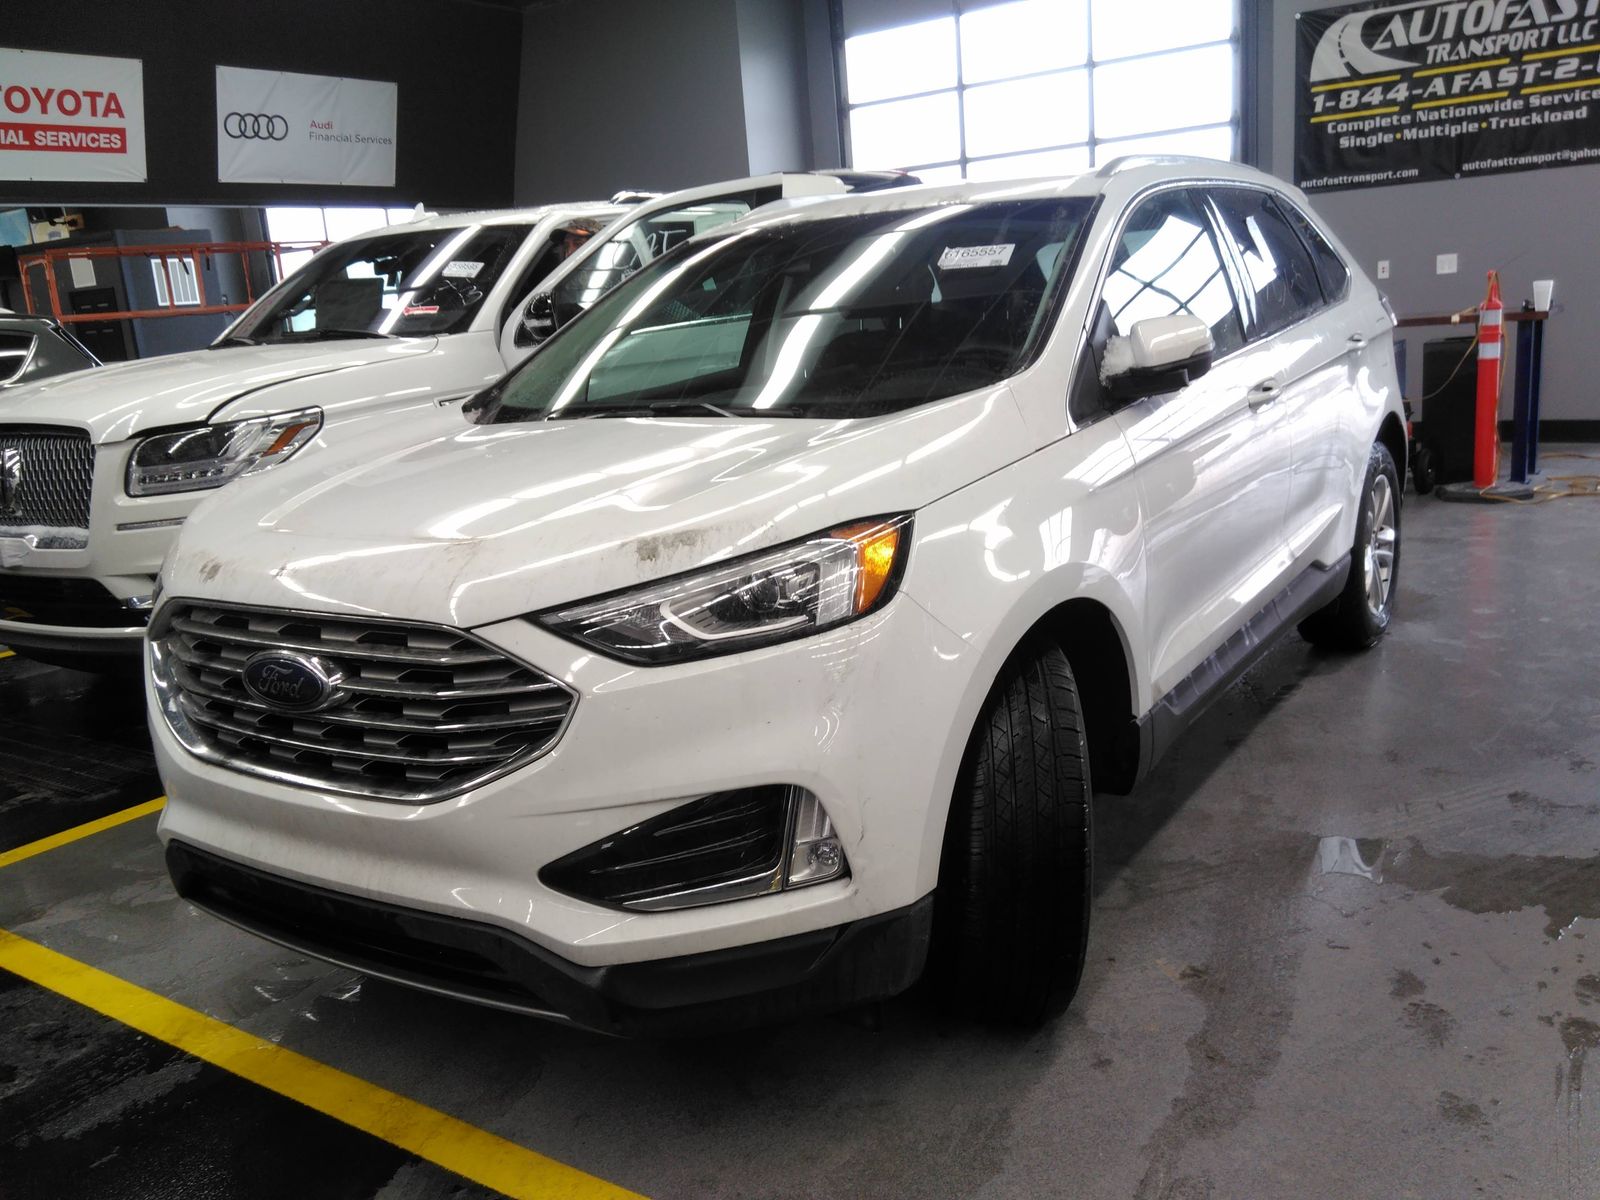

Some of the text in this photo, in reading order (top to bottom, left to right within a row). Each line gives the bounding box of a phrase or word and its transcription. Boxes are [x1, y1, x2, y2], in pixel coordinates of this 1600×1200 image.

[1426, 19, 1598, 64] TRANSPORT LLC
[1313, 54, 1600, 113] 1-844-AFAST-2-
[0, 84, 125, 118] OYOTA
[1327, 114, 1411, 134] Complete
[1416, 98, 1524, 123] Nationwide
[34, 130, 122, 149] SERVICES
[309, 131, 393, 145] Financial Services
[310, 120, 333, 130] Audi
[1339, 106, 1588, 148] Single Multiple Truckload
[1300, 168, 1419, 188] autofasttransport.com
[259, 664, 304, 698] Ford
